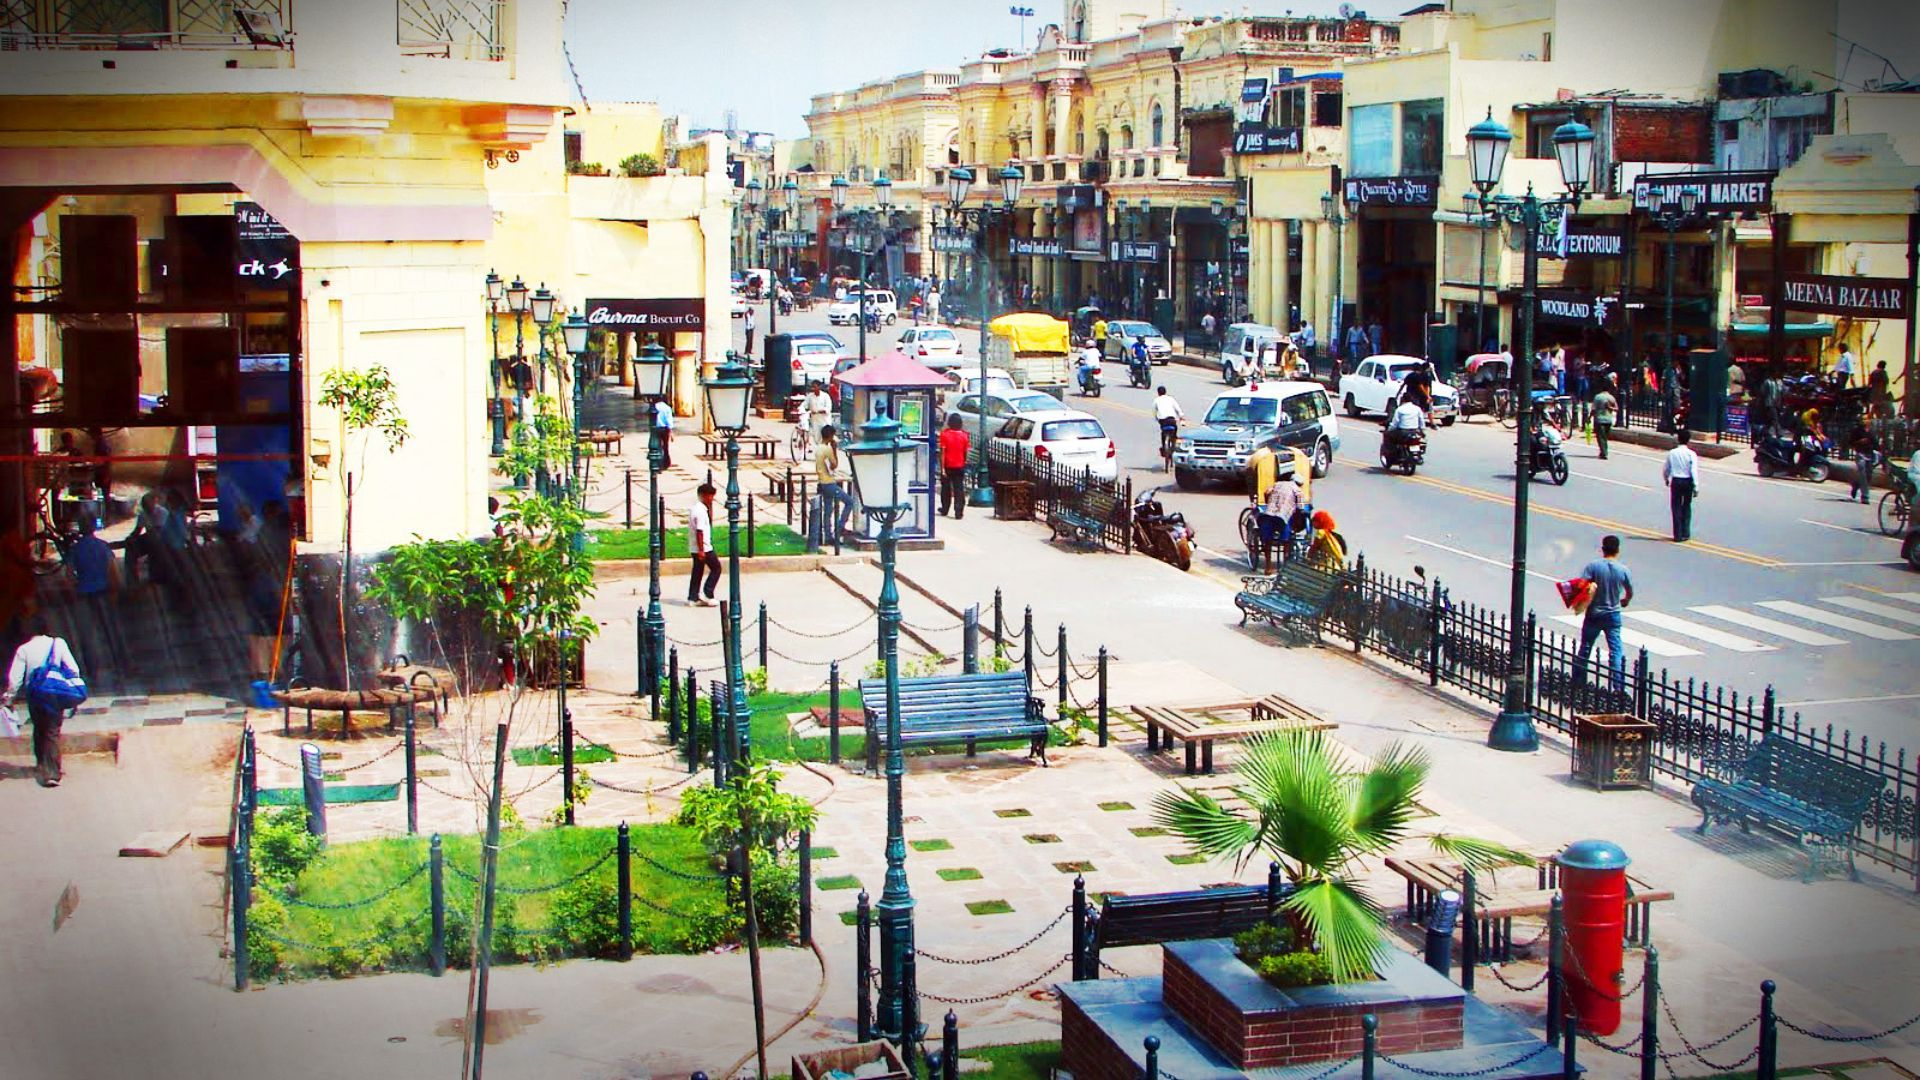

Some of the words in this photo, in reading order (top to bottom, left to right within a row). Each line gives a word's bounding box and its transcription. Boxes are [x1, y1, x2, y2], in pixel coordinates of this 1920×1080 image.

[1711, 182, 1766, 203] MARKET
[1565, 234, 1621, 254] TEXTORIUM
[1784, 281, 1834, 305] MEENA
[1838, 286, 1901, 309] BAZAAR
[588, 307, 647, 324] Burma
[1541, 299, 1590, 318] WOODLAND
